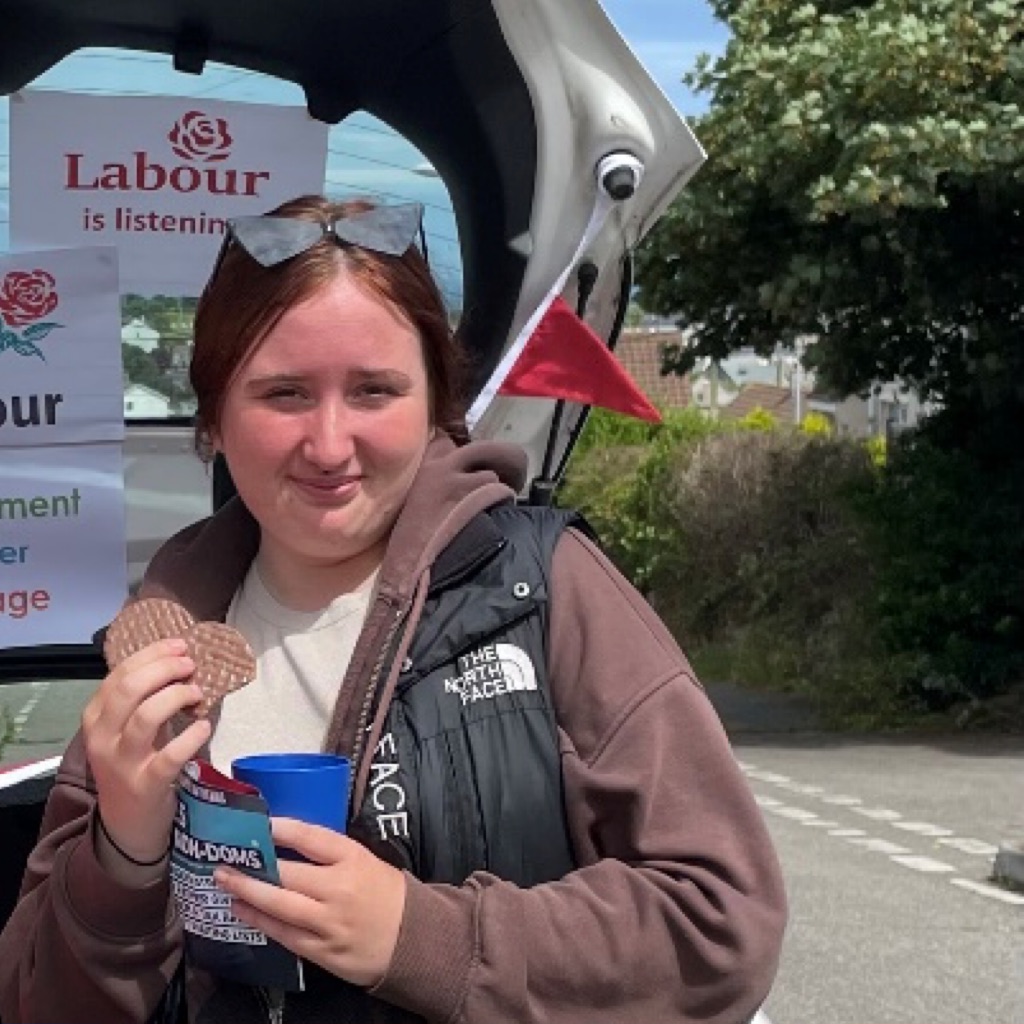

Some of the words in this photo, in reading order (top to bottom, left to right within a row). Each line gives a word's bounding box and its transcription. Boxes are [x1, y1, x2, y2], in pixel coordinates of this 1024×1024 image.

[64, 151, 270, 197] Labour
[83, 208, 105, 231] is
[115, 207, 228, 234] listenin
[458, 644, 497, 669] THE
[444, 661, 505, 694] NORTH
[460, 679, 509, 706] FACE
[370, 733, 410, 841] FACE
